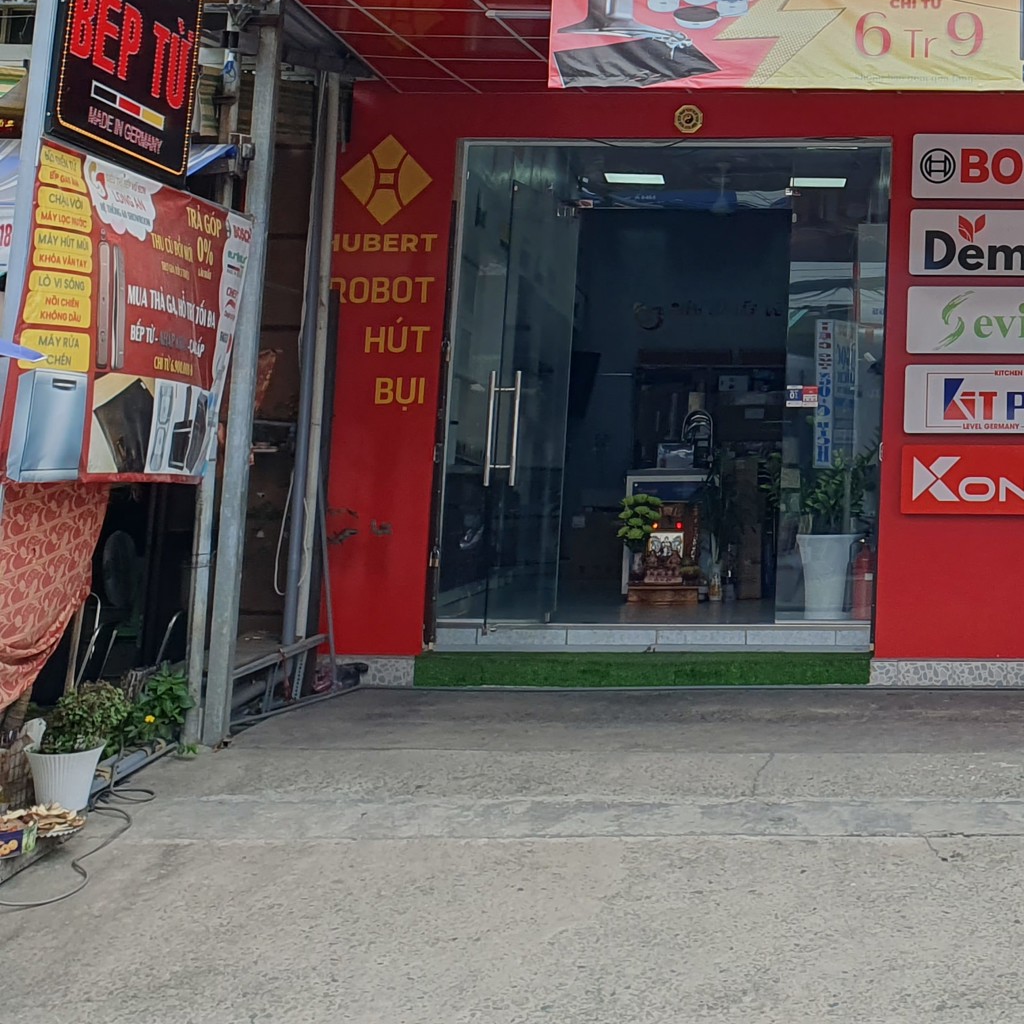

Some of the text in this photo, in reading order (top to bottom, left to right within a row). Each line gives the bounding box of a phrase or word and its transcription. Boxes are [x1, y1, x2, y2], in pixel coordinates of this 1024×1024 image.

[854, 11, 892, 57] 6
[946, 11, 984, 57] 9
[127, 284, 148, 308] MUA
[330, 276, 435, 304] ROBOT
[364, 316, 431, 353] HÚT
[374, 377, 426, 412] BỤI
[983, 422, 1020, 430] GERMANY
